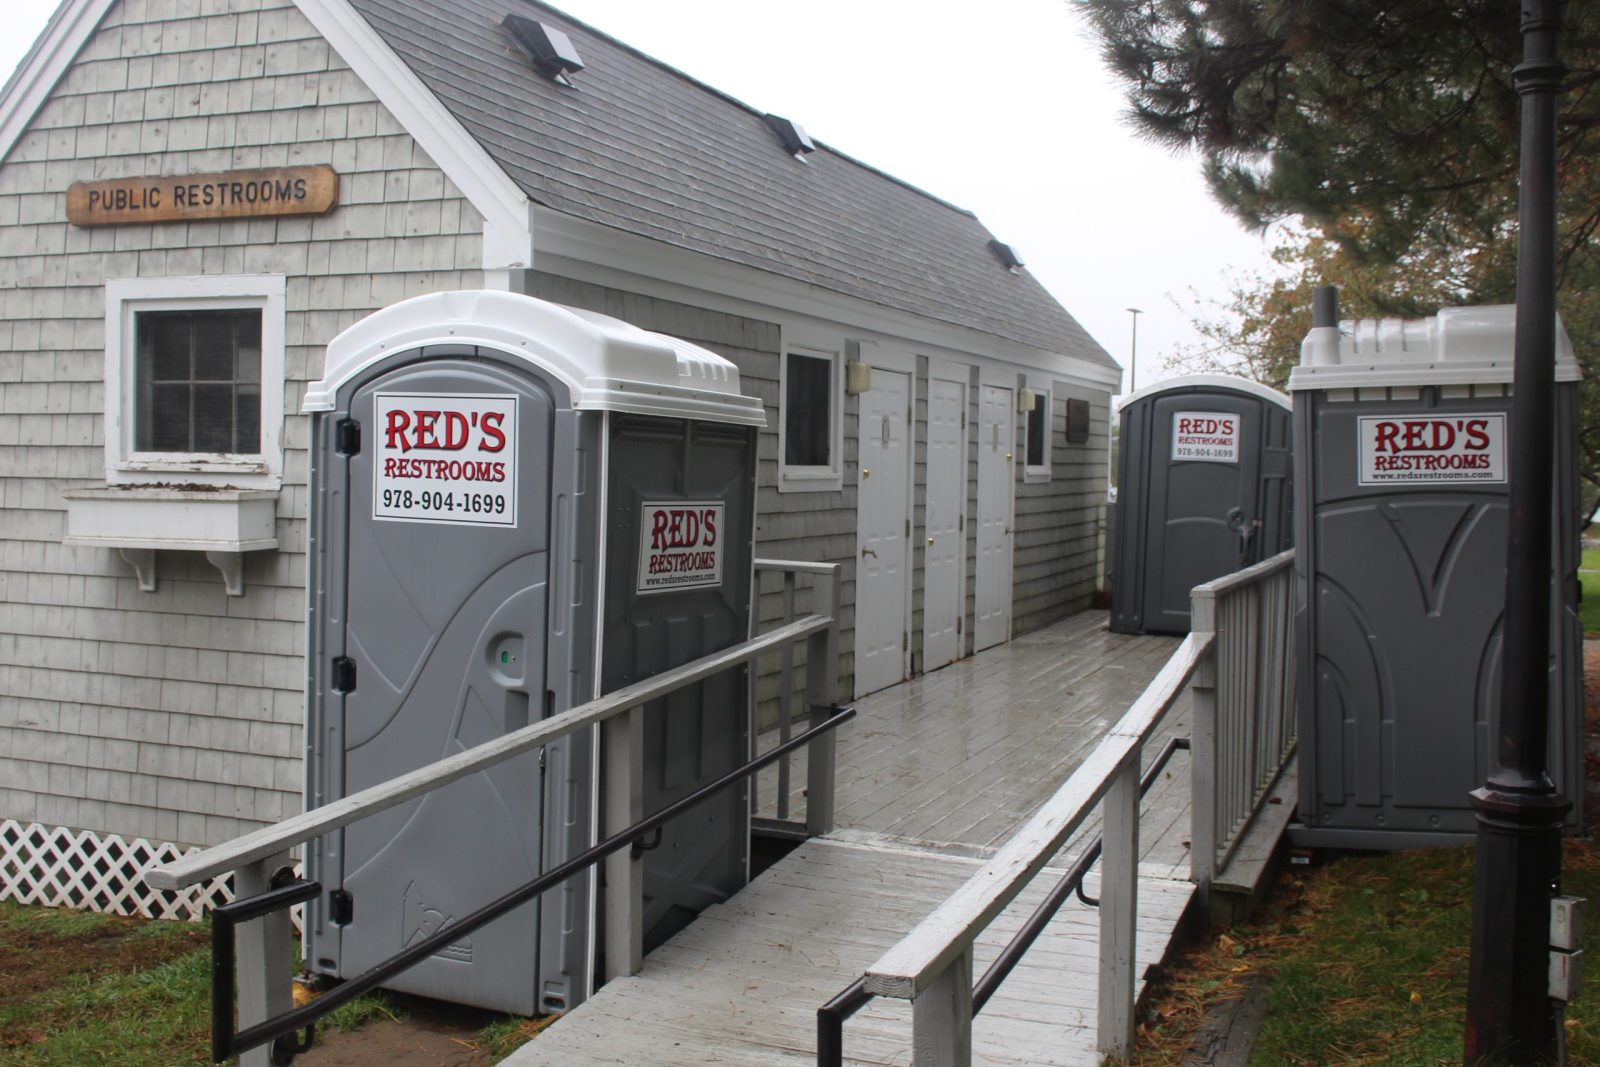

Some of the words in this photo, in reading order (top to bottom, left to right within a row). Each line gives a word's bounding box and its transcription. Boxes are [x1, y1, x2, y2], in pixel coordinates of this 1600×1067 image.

[89, 187, 161, 212] PUBLIC
[173, 179, 307, 207] RESTROOMS
[385, 409, 506, 454] RED'S
[1179, 418, 1234, 435] RED'S
[1375, 420, 1490, 455] RED'S
[1177, 447, 1233, 458] 978-904-1699
[1178, 436, 1233, 446] RESTROOMS
[384, 458, 506, 482] RESTROOMS
[1375, 454, 1490, 471] RESTROOMS
[1372, 471, 1493, 480] www.redsrestrooms.com
[383, 489, 505, 514] 978-904-1699
[651, 509, 716, 553] RED'S
[649, 551, 715, 575] RESTROOMS
[646, 573, 715, 586] www.redsrestrooms.com
